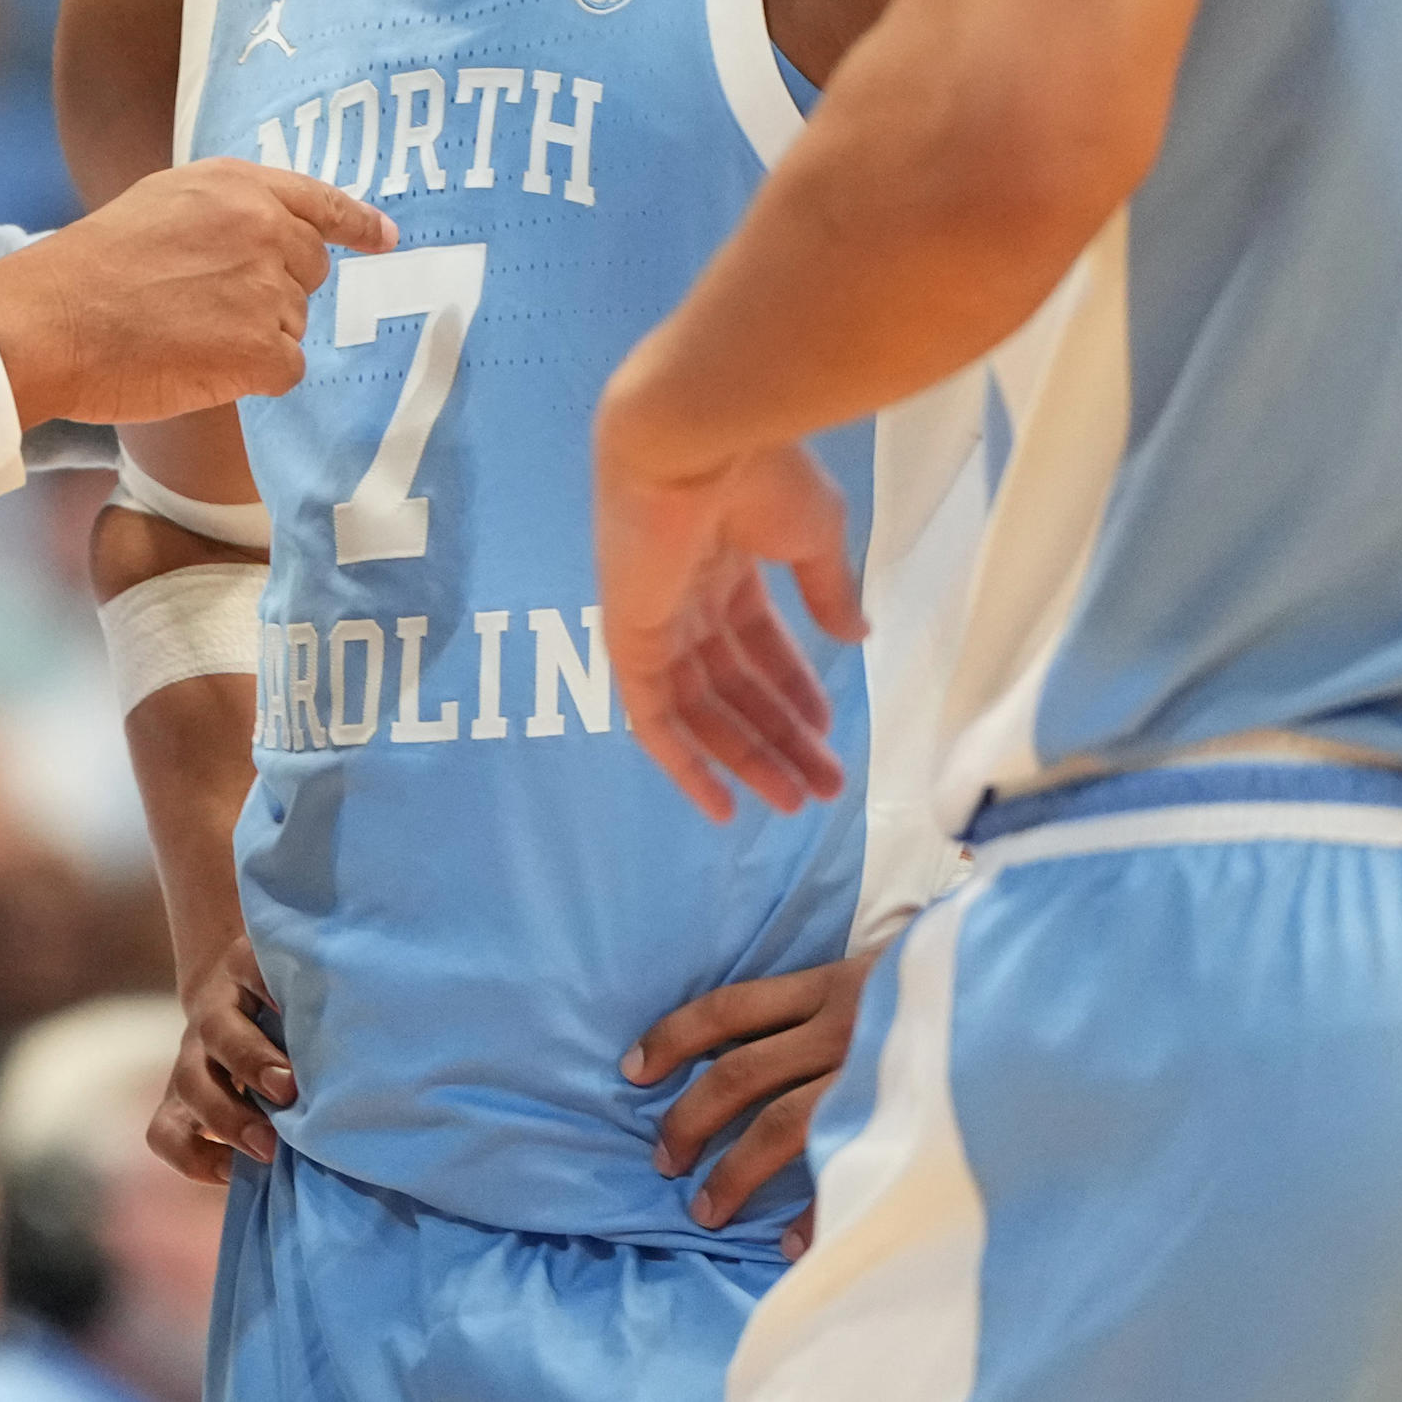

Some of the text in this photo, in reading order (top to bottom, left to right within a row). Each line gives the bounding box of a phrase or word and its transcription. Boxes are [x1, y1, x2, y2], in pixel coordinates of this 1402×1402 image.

[258, 68, 603, 206] NORTH
[334, 243, 487, 565] 7
[253, 606, 633, 753] AROLIN
